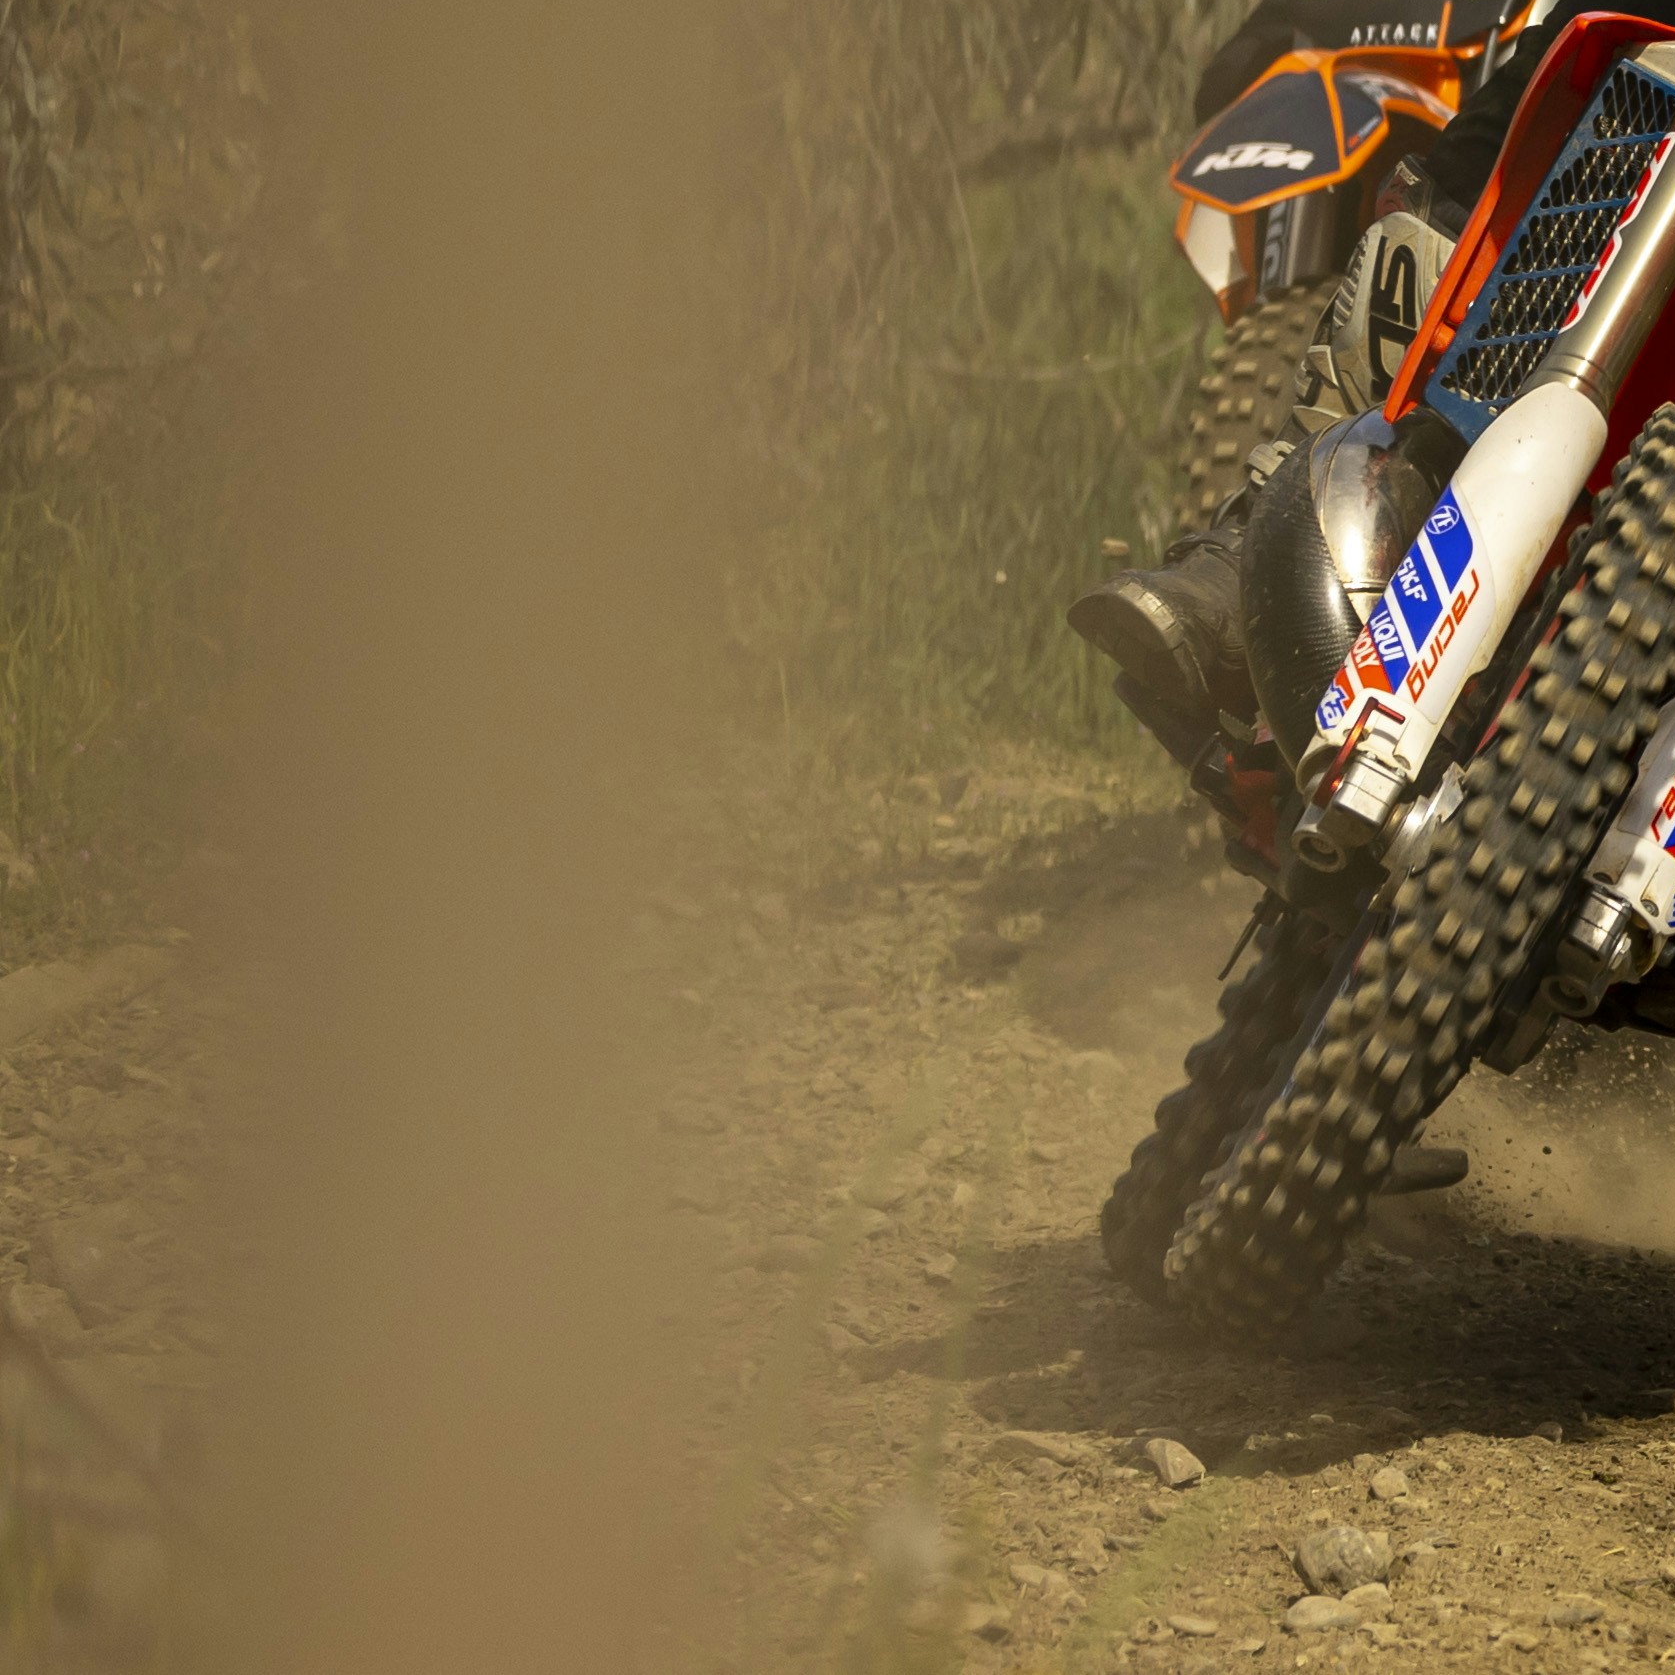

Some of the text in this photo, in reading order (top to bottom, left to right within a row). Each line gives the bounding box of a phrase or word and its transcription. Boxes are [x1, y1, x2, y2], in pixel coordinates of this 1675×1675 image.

[1191, 142, 1315, 177] KTM
[1428, 506, 1456, 533] ZF
[1398, 556, 1428, 603] SKF
[1369, 610, 1405, 662] LIQUI
[1405, 567, 1480, 704] racing
